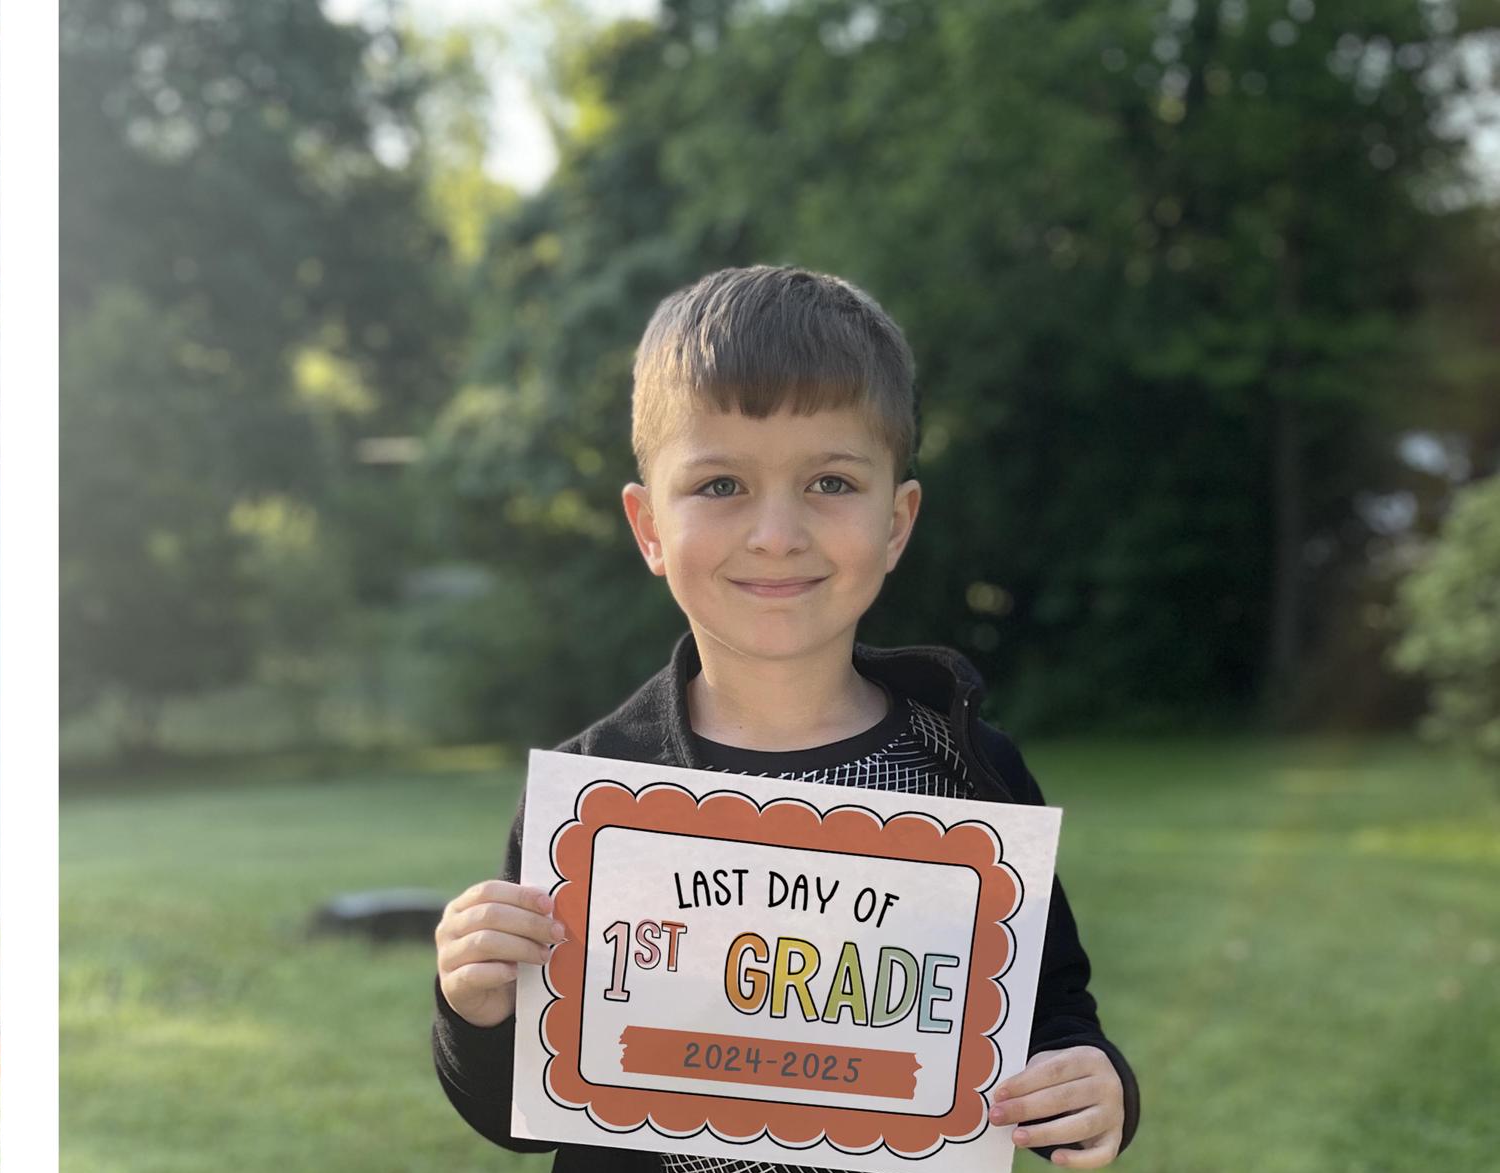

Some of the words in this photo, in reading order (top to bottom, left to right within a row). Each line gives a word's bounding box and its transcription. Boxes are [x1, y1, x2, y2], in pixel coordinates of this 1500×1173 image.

[674, 870, 749, 909] LAST
[767, 871, 840, 914] DAY
[853, 887, 900, 928] OF
[602, 919, 688, 1002] 1ST
[723, 931, 960, 1034] GRADE
[682, 1041, 863, 1084] 2024-2025
